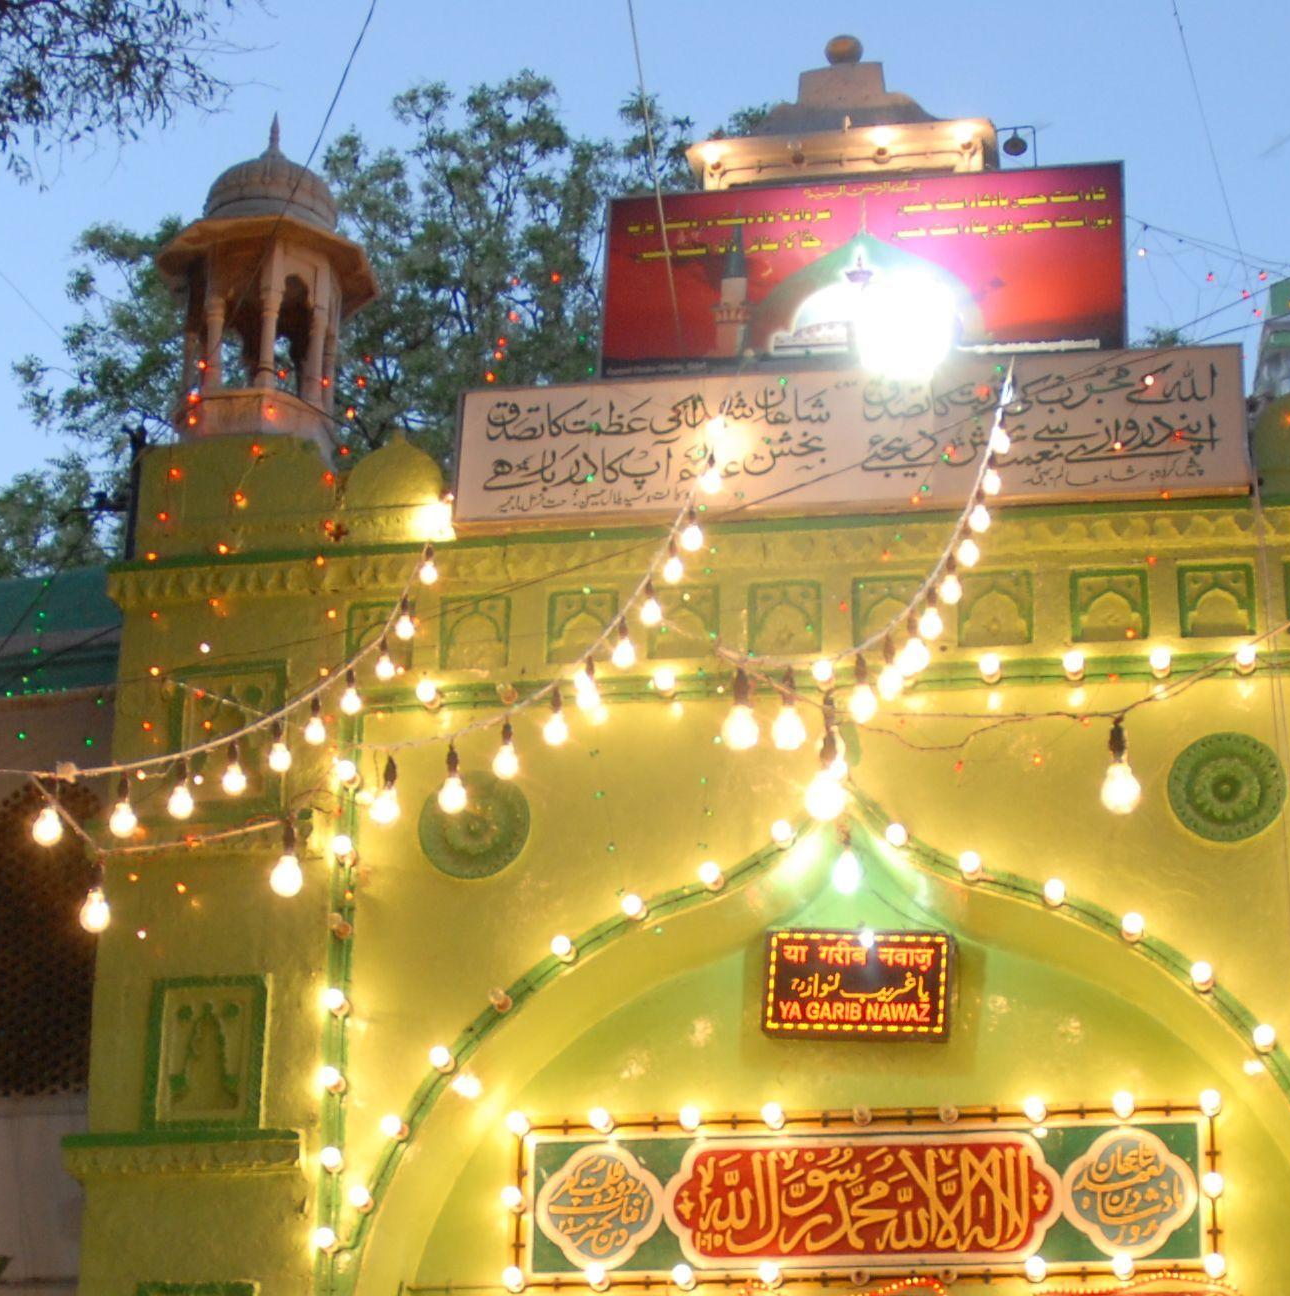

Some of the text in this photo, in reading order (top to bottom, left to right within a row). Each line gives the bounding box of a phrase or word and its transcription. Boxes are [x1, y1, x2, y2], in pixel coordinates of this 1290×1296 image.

[783, 944, 809, 963] या
[818, 940, 869, 966] गरीब
[840, 971, 917, 1004] غریب
[778, 1001, 931, 1022] YA GARIB NAWAZ
